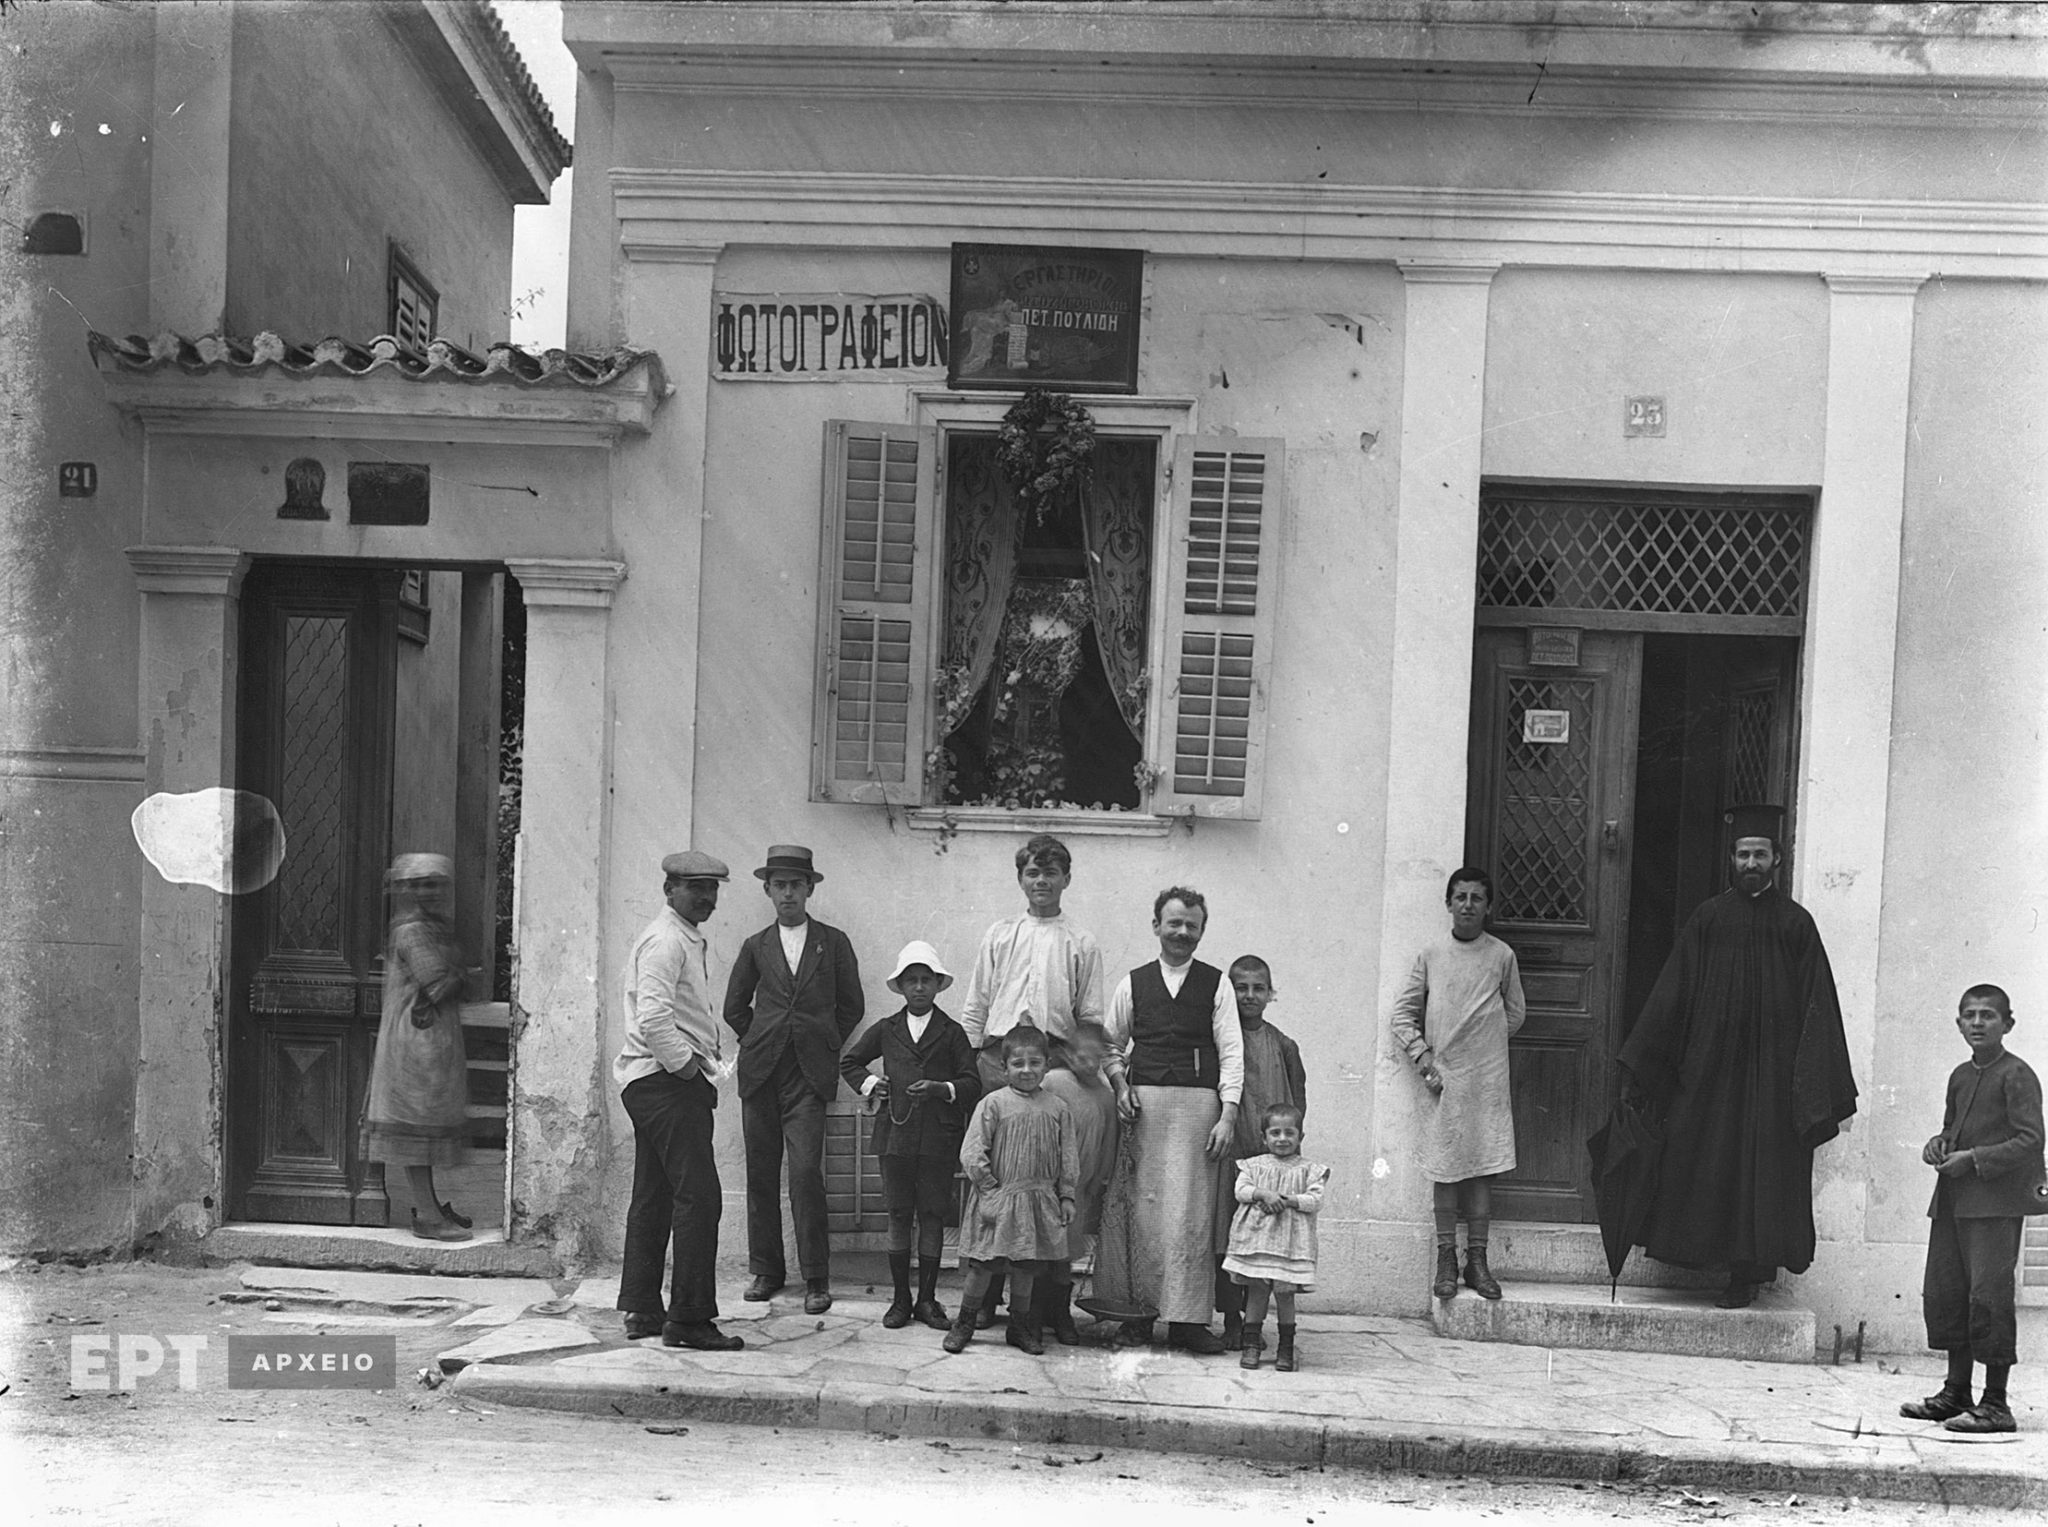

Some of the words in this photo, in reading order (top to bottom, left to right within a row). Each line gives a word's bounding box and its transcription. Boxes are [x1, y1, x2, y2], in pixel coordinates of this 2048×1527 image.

[1053, 310, 1119, 332] ΠΟΥΛΙΔΗ
[717, 303, 949, 372] ΦΩΤΟΓΡΑΦΕΙΟΝ
[64, 466, 90, 488] 21
